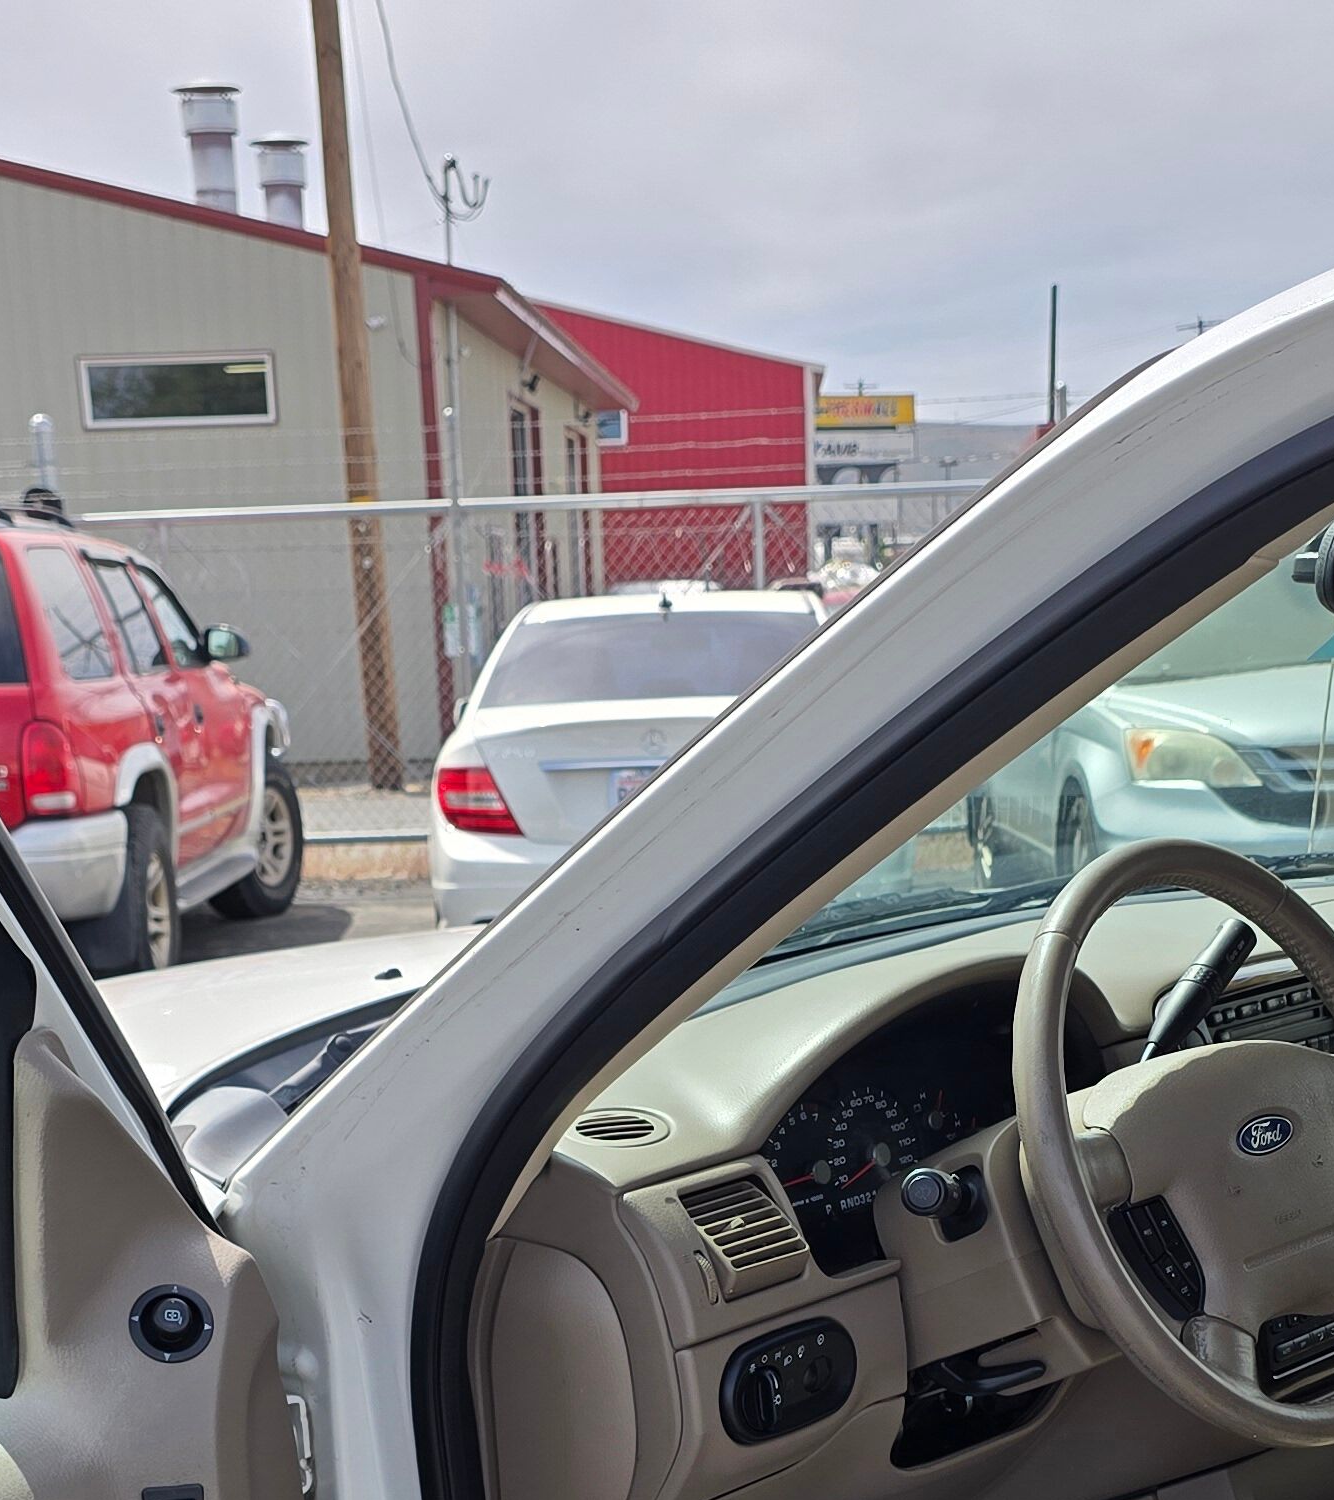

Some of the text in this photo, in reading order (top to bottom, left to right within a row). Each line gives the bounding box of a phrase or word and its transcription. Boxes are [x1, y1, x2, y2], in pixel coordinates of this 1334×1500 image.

[850, 1097, 863, 1108] 60
[863, 1094, 875, 1104] 70
[875, 1099, 887, 1109] 80
[799, 1112, 807, 1120] 6
[812, 1113, 819, 1121] 7
[841, 1108, 853, 1119] 50
[885, 1108, 898, 1118] 90
[789, 1117, 795, 1126] 5
[891, 1121, 906, 1132] 100
[778, 1127, 785, 1135] 4
[834, 1122, 848, 1132] 40
[1251, 1121, 1283, 1149] Ford
[773, 1141, 781, 1151] 3
[832, 1138, 845, 1149] 30
[898, 1137, 912, 1148] 110
[771, 1159, 778, 1168] 2
[833, 1156, 846, 1166] 20
[898, 1153, 913, 1165] 120
[838, 1174, 849, 1183] 10
